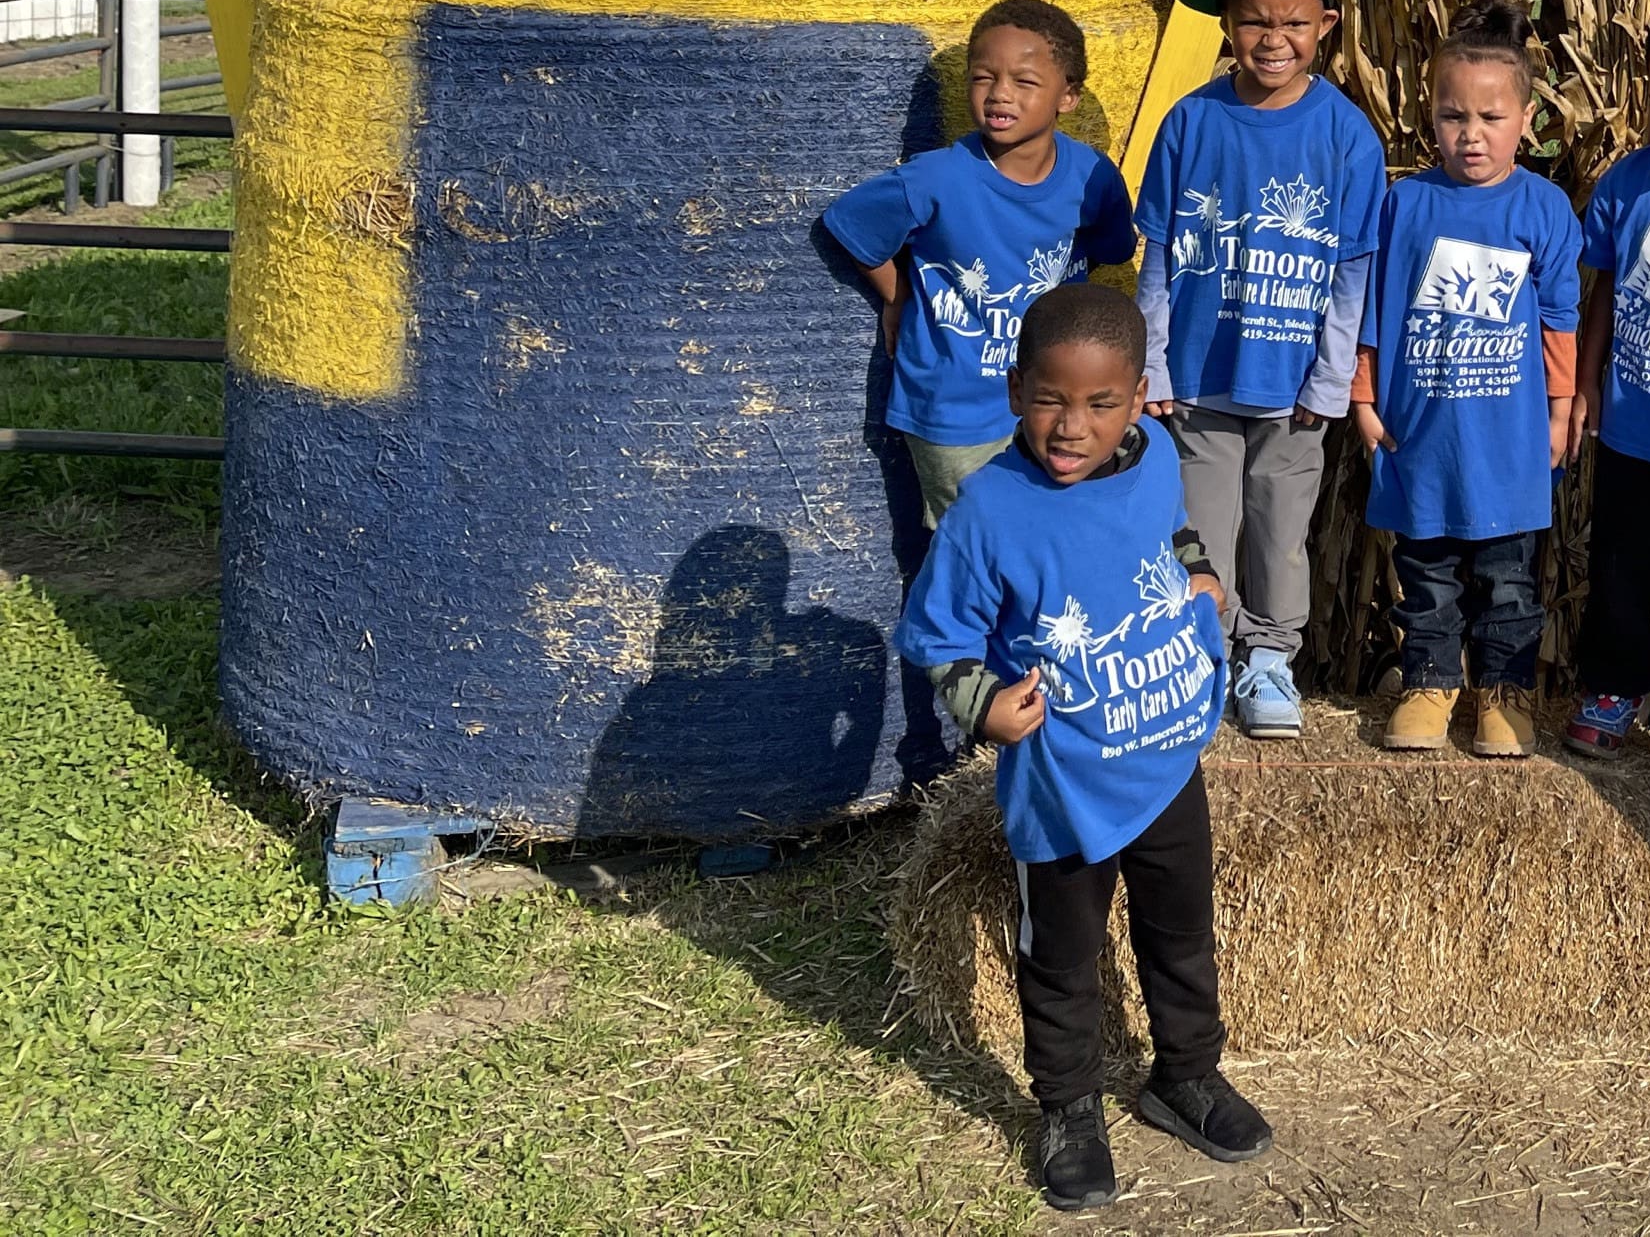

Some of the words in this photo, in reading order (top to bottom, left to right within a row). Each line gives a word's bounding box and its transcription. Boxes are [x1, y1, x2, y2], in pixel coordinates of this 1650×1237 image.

[981, 340, 1009, 369] Early
[1456, 377, 1480, 387] OH
[1458, 364, 1518, 377] Bancroft
[1104, 696, 1137, 735] Early
[1141, 689, 1169, 722] Care
[1101, 746, 1123, 760] 890
[1125, 740, 1139, 753] W.
[1141, 720, 1185, 748] Bancroft
